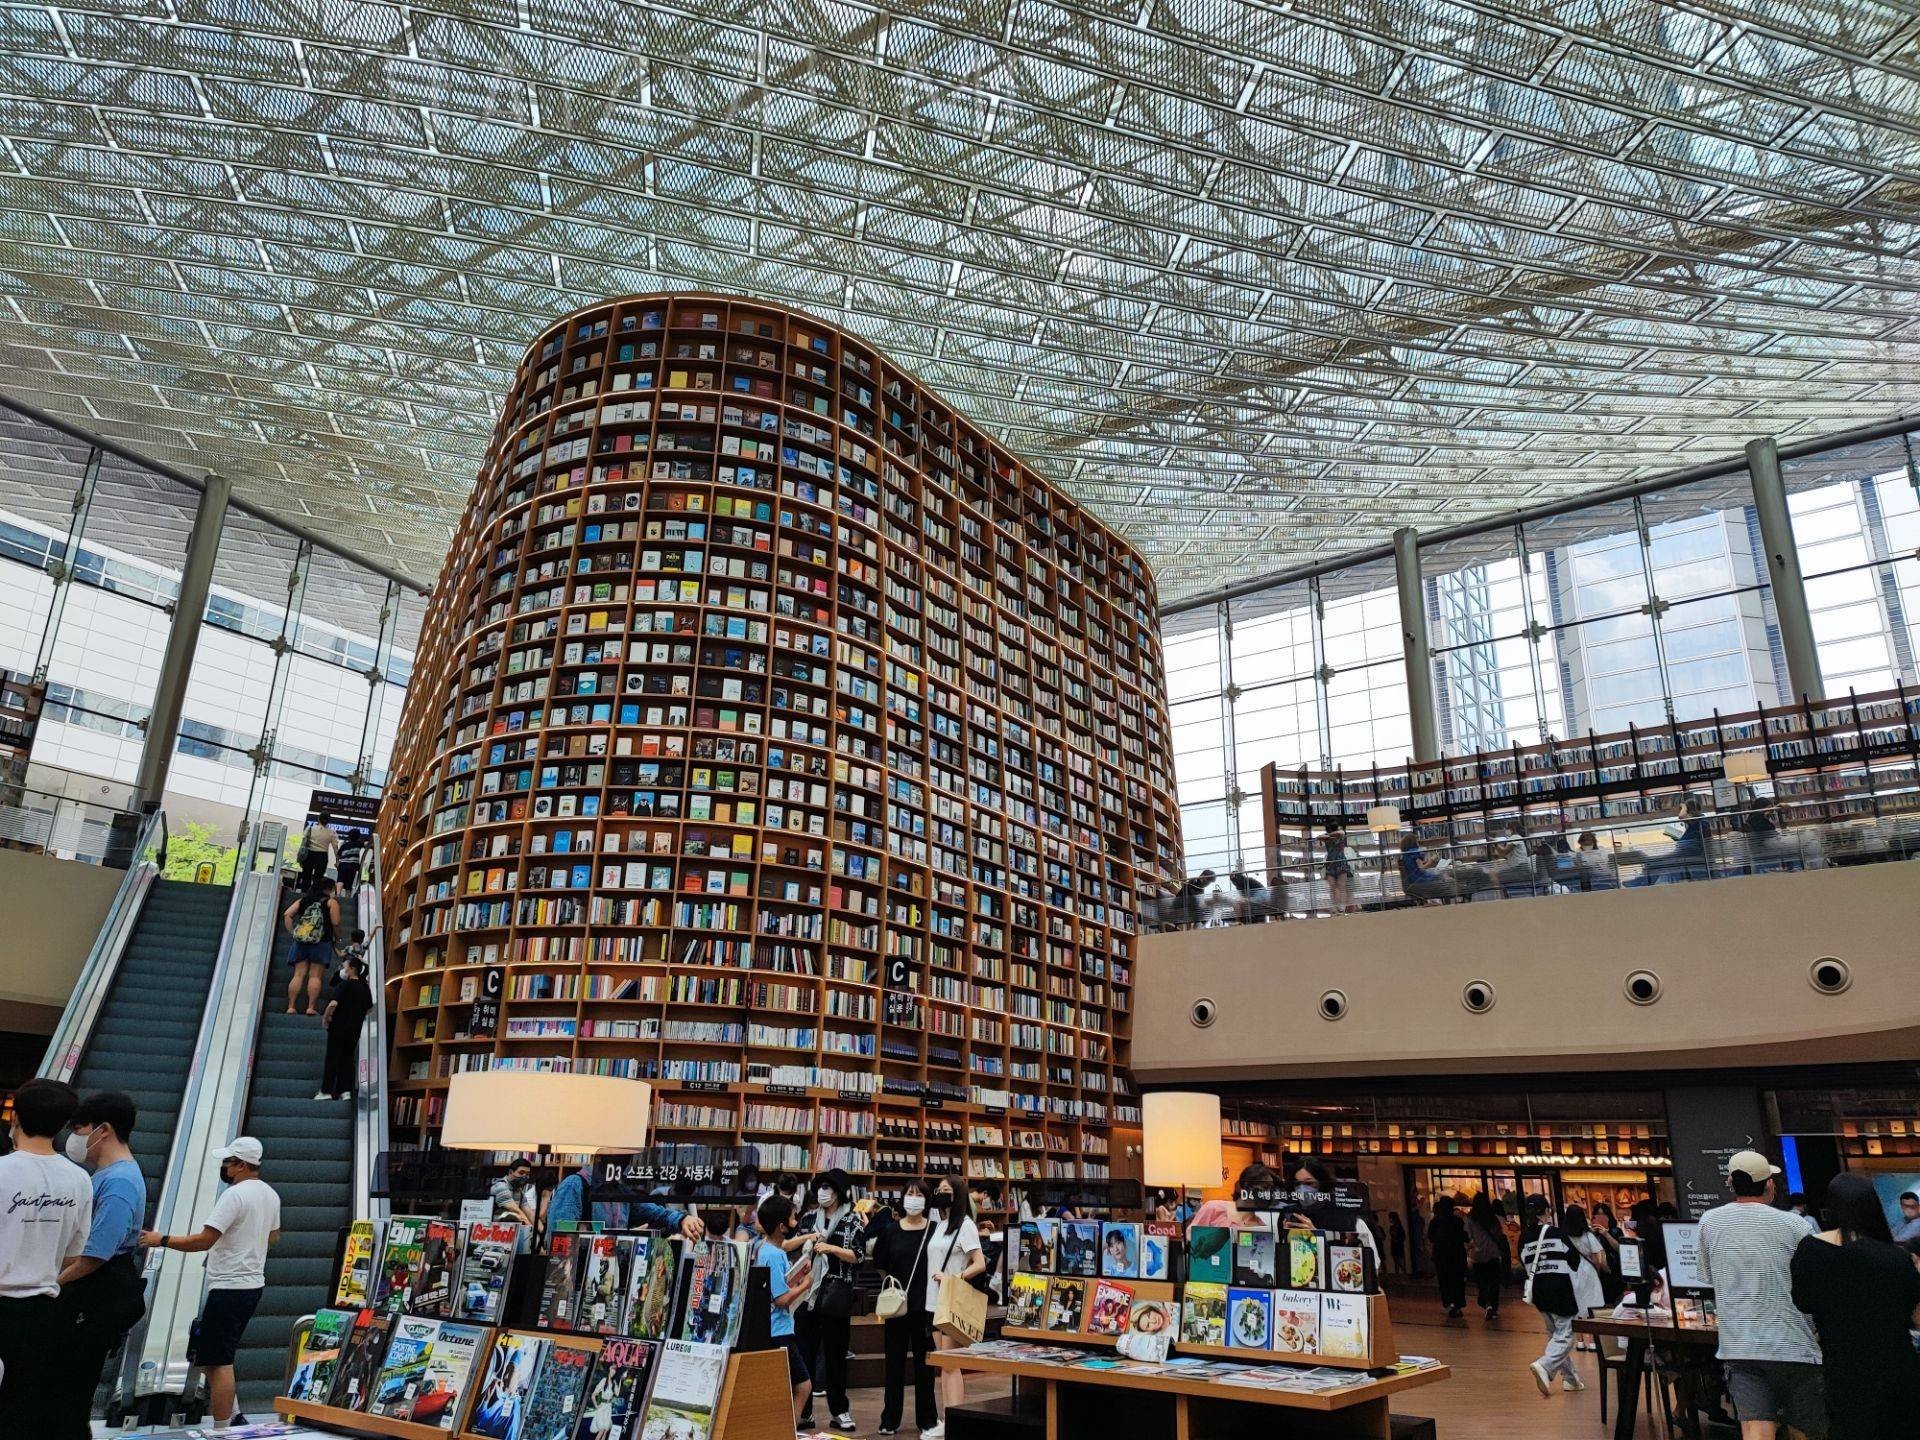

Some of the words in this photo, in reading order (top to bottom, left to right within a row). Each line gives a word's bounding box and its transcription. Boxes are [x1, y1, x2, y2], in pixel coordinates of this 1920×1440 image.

[892, 961, 905, 982] C
[487, 970, 499, 993] C
[722, 1159, 740, 1168] Sports
[605, 1163, 622, 1182] D3
[721, 1168, 739, 1176] Health
[720, 1177, 730, 1185] Car
[1240, 1189, 1255, 1201] D4
[389, 1226, 416, 1245] 911
[1148, 1224, 1177, 1236] Good
[1282, 1292, 1314, 1305] bakery
[438, 1331, 475, 1347] Octane
[599, 1340, 640, 1368] AQUA
